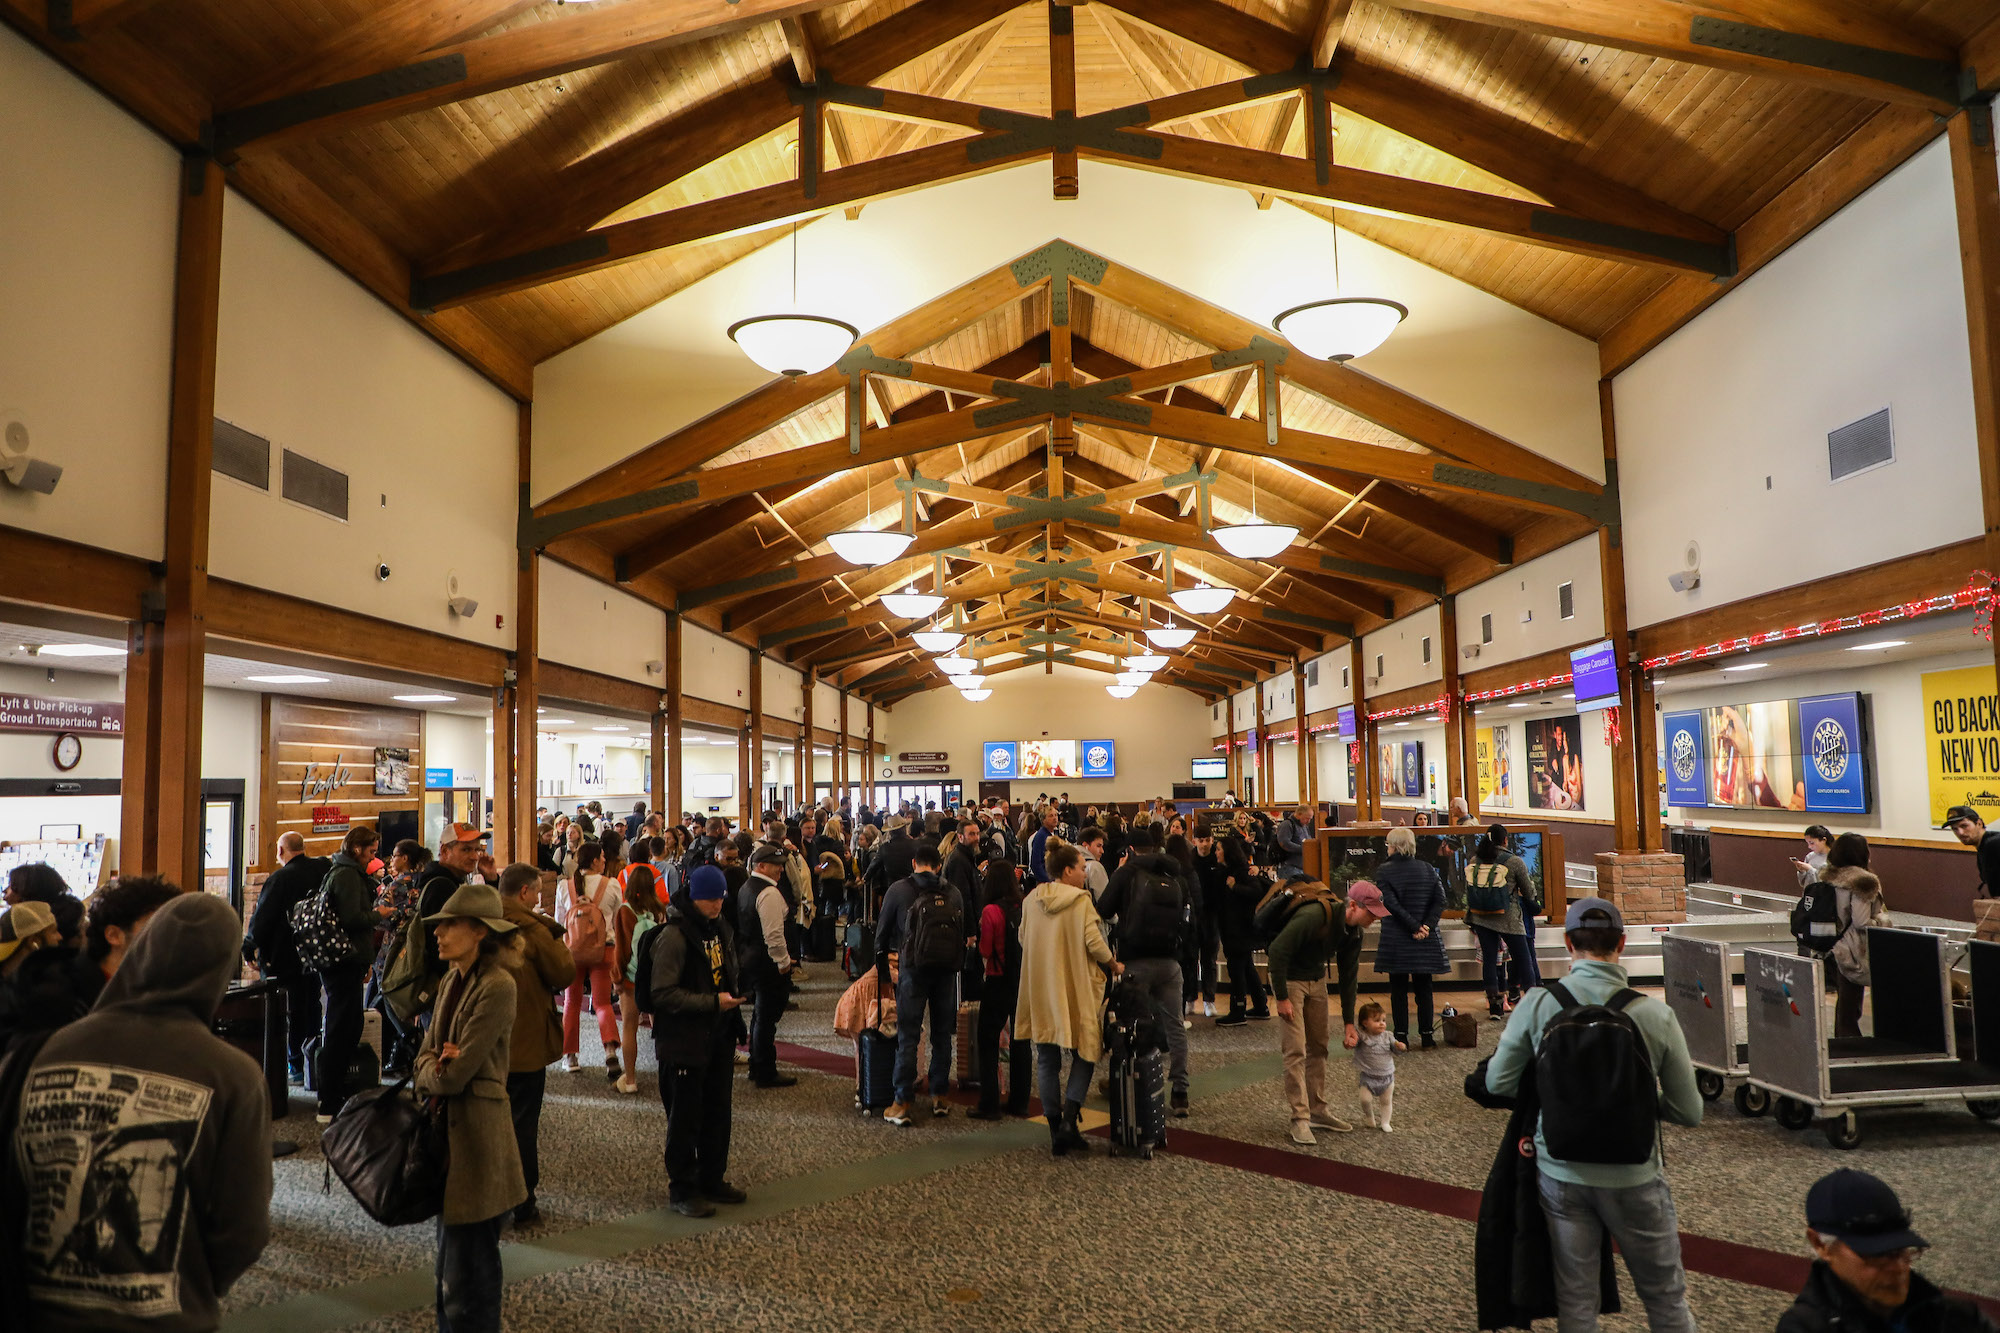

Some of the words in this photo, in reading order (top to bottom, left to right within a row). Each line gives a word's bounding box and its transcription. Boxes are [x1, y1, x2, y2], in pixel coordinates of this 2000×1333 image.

[1573, 661, 1591, 674] Baggage
[1590, 655, 1610, 669] Carousel
[0, 696, 20, 711] Lyft
[22, 698, 30, 710] &
[33, 699, 56, 711] Uber
[58, 701, 93, 716] Pick-up
[1934, 699, 1954, 735] GO
[1957, 694, 2000, 733] BACK
[0, 711, 34, 724] Ground
[36, 713, 97, 728] Transportation
[1815, 722, 1843, 742] BLADE
[1940, 737, 1974, 774] NEW
[1815, 756, 1831, 777] AND
[1831, 754, 1846, 778] BOW
[300, 753, 353, 806] Eagle
[71, 1090, 91, 1101] THE
[25, 1103, 120, 1124] HORRIFYING
